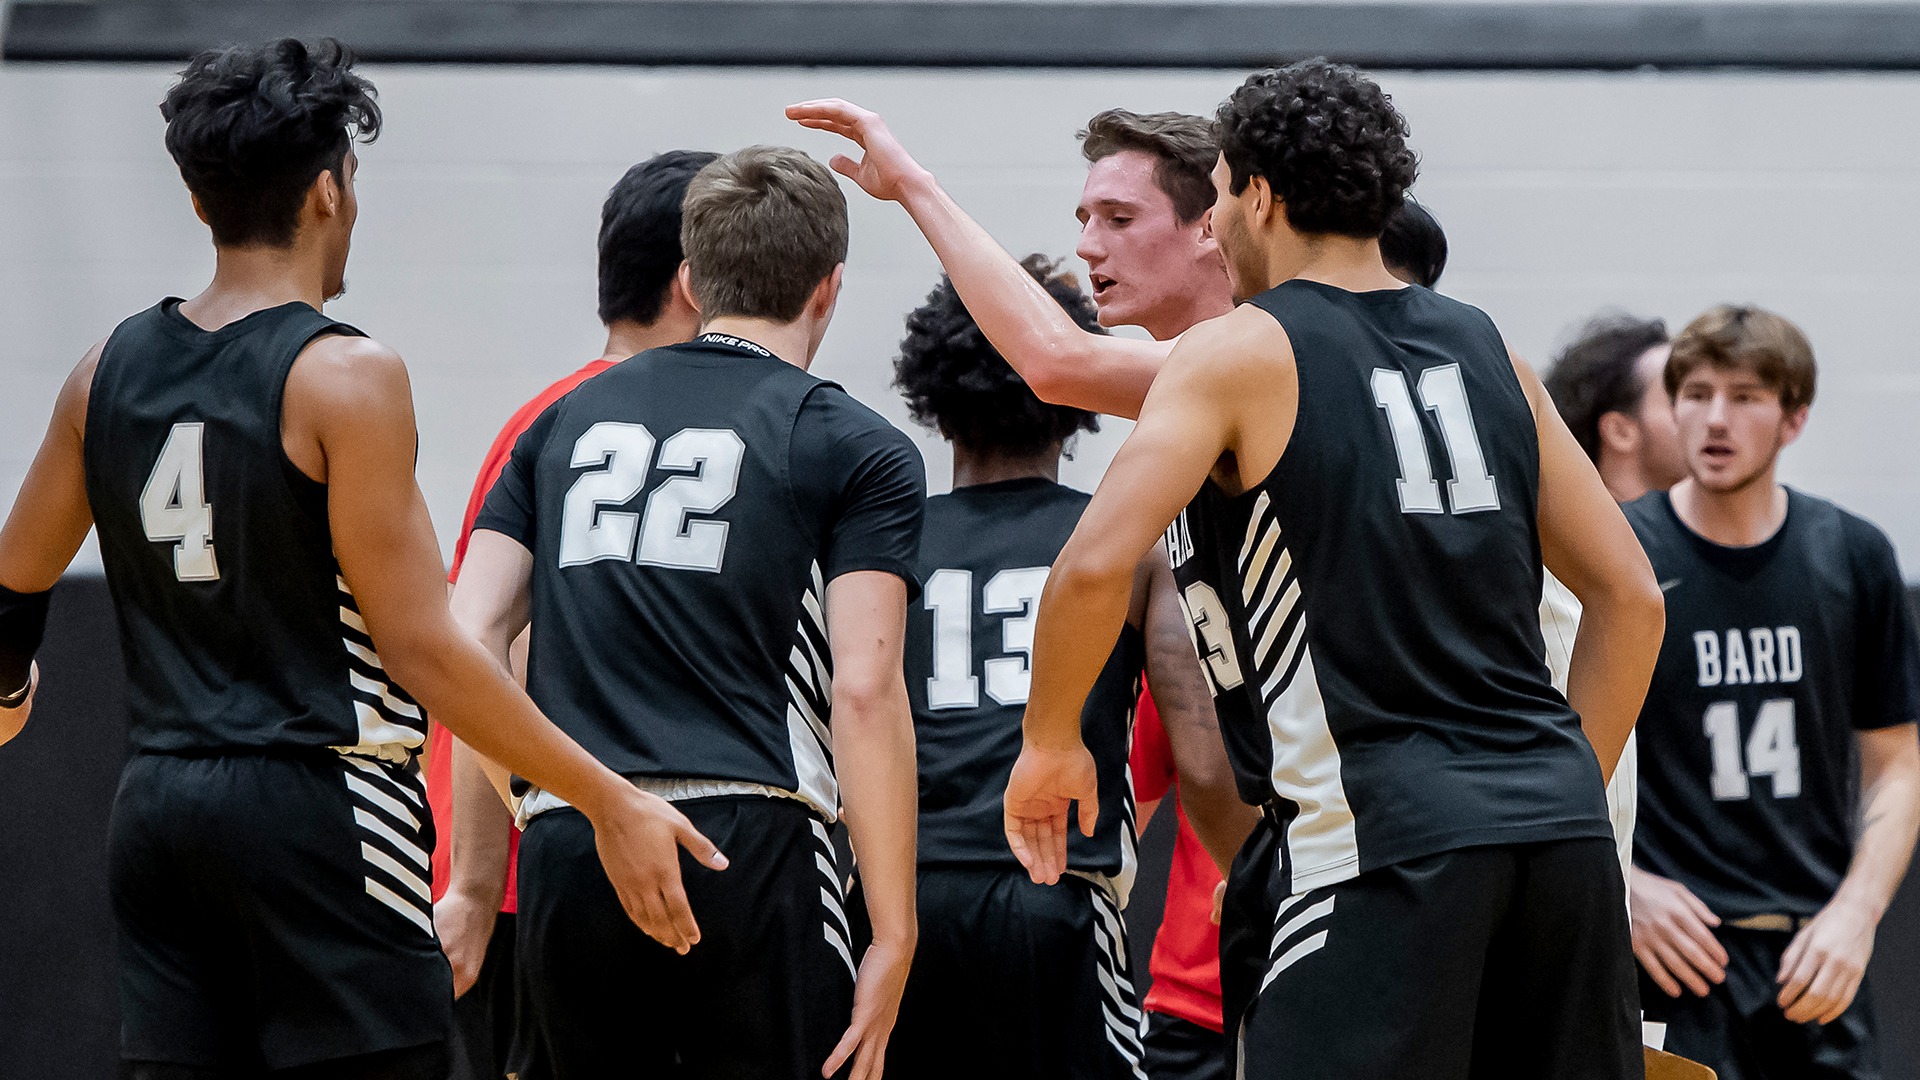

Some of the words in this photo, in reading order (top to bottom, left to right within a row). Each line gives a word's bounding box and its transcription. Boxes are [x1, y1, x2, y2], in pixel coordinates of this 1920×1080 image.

[703, 334, 740, 346] NIKE
[738, 341, 771, 357] PRO
[139, 422, 221, 582] 4
[559, 421, 746, 574] 22
[1370, 363, 1501, 515] 11
[924, 566, 1052, 710] 13
[1177, 580, 1245, 699] 3
[1692, 625, 1803, 687] BARD
[1702, 698, 1801, 801] 14
